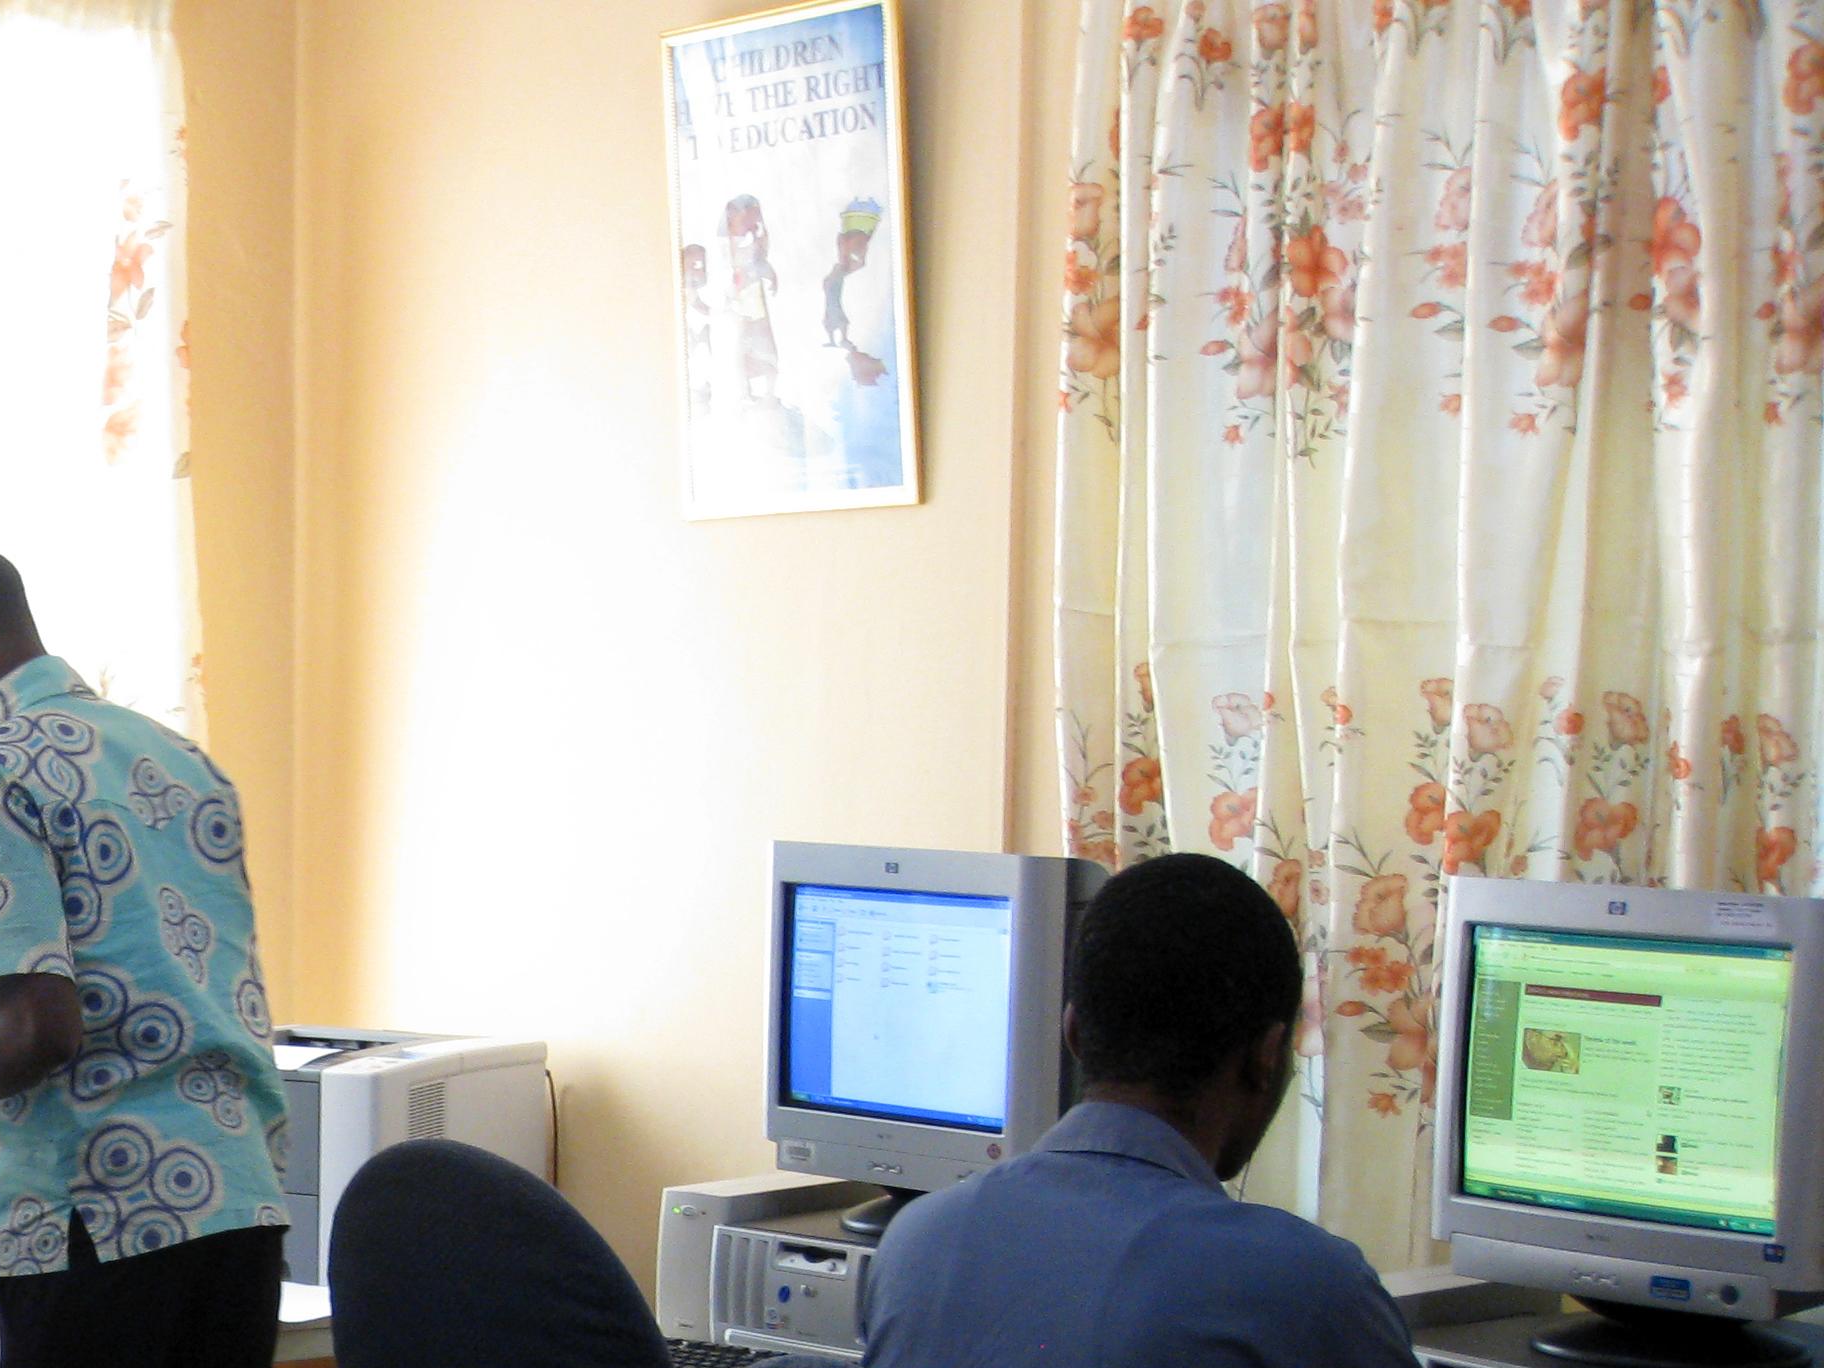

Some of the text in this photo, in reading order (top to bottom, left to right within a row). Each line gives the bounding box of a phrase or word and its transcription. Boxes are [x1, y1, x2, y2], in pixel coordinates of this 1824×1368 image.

[746, 79, 797, 113] THE
[805, 62, 884, 103] RIGHT
[729, 102, 877, 154] EDUCATION
